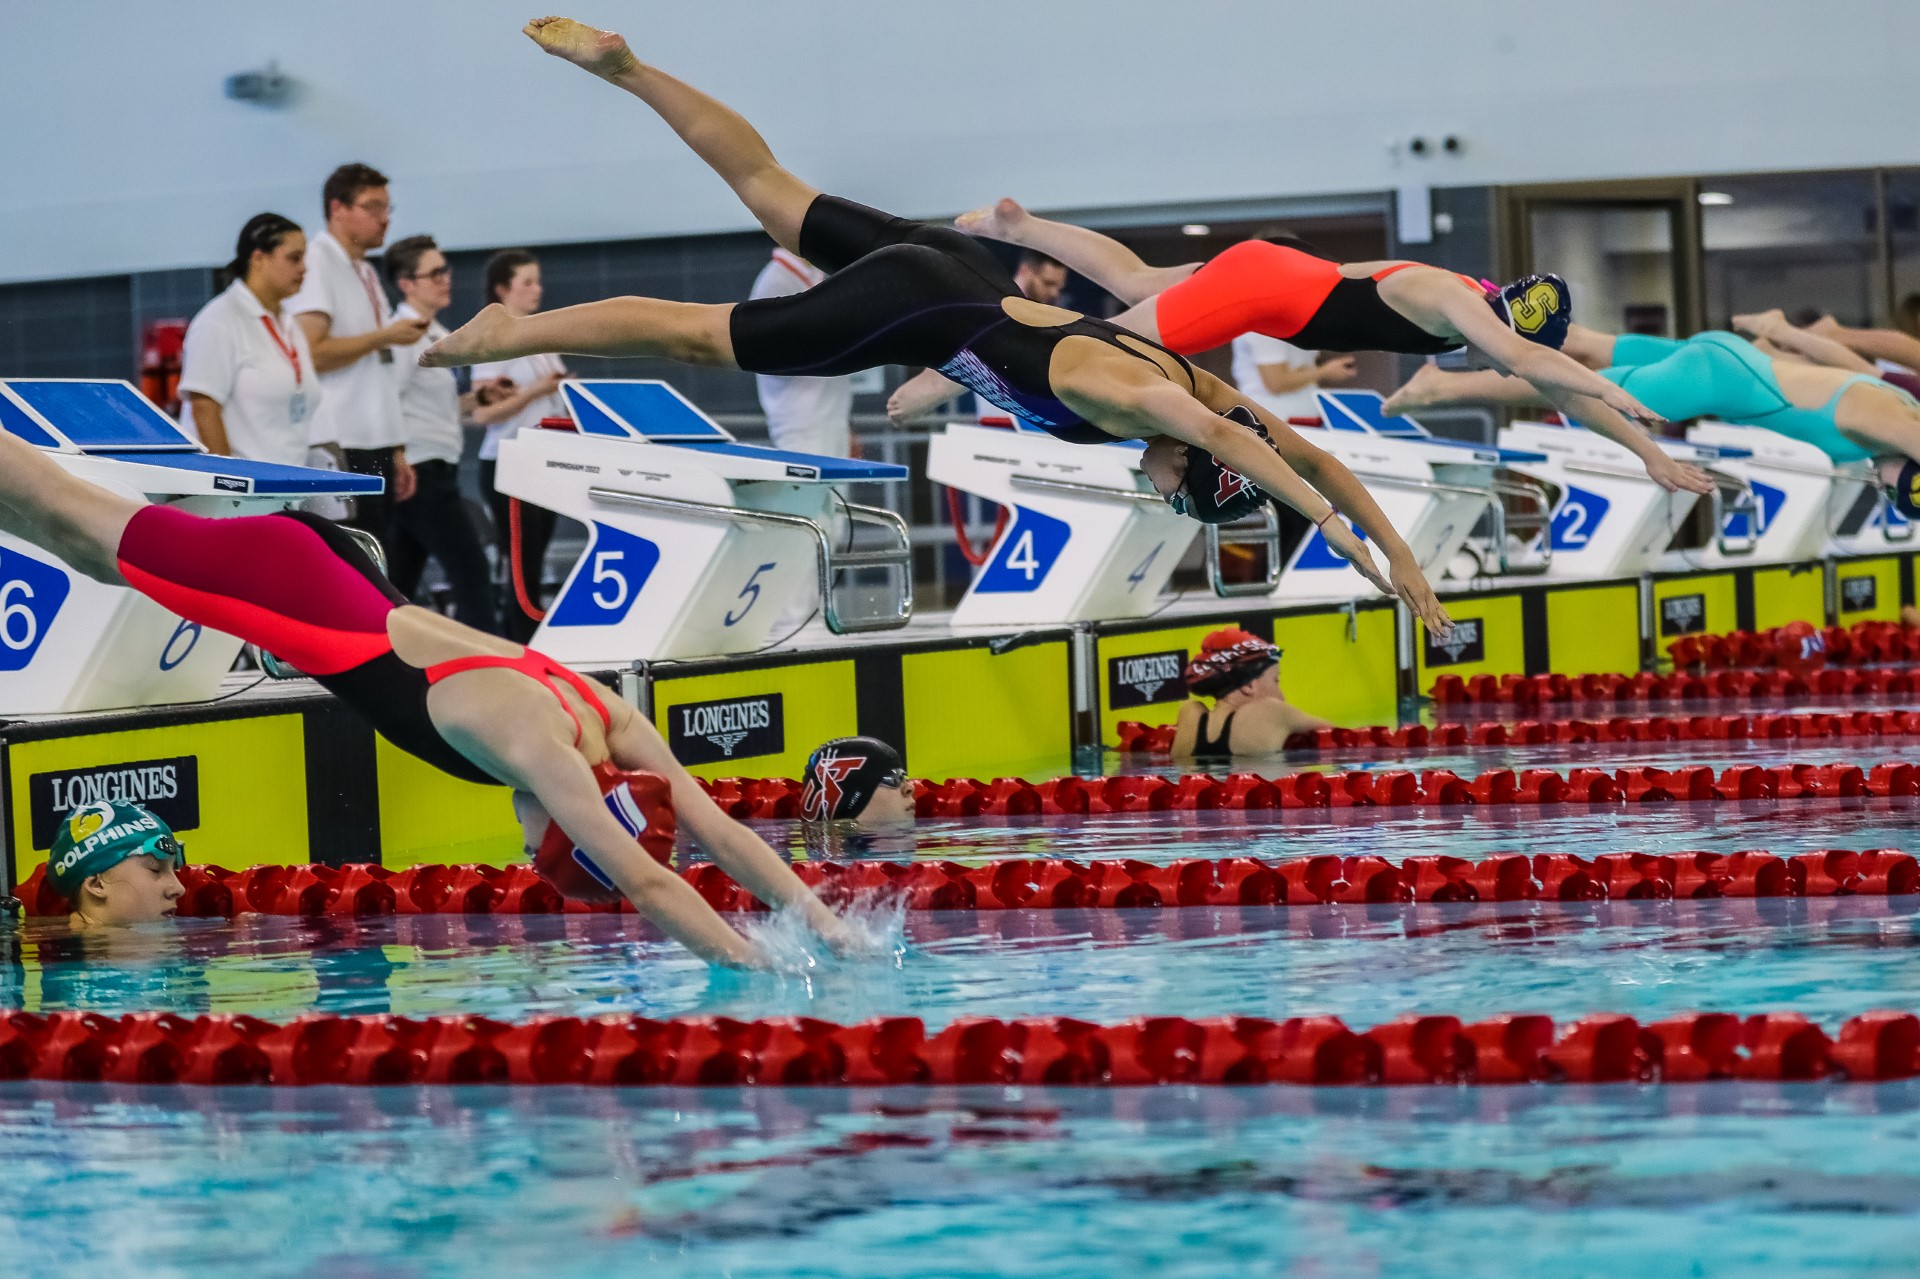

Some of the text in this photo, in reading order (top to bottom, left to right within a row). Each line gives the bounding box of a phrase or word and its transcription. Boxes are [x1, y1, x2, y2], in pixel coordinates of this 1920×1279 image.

[1509, 282, 1559, 334] S
[1562, 502, 1588, 543] 2
[592, 551, 628, 610] 5
[1006, 530, 1039, 580] 4
[1128, 541, 1165, 593] 4
[0, 580, 37, 650] 6
[724, 562, 777, 627] 5
[160, 619, 201, 671] 6
[1117, 654, 1179, 685] LONGINES
[682, 700, 769, 737] LONGINES
[52, 765, 178, 812] LONGINES
[54, 816, 158, 877] DOLPHINS
